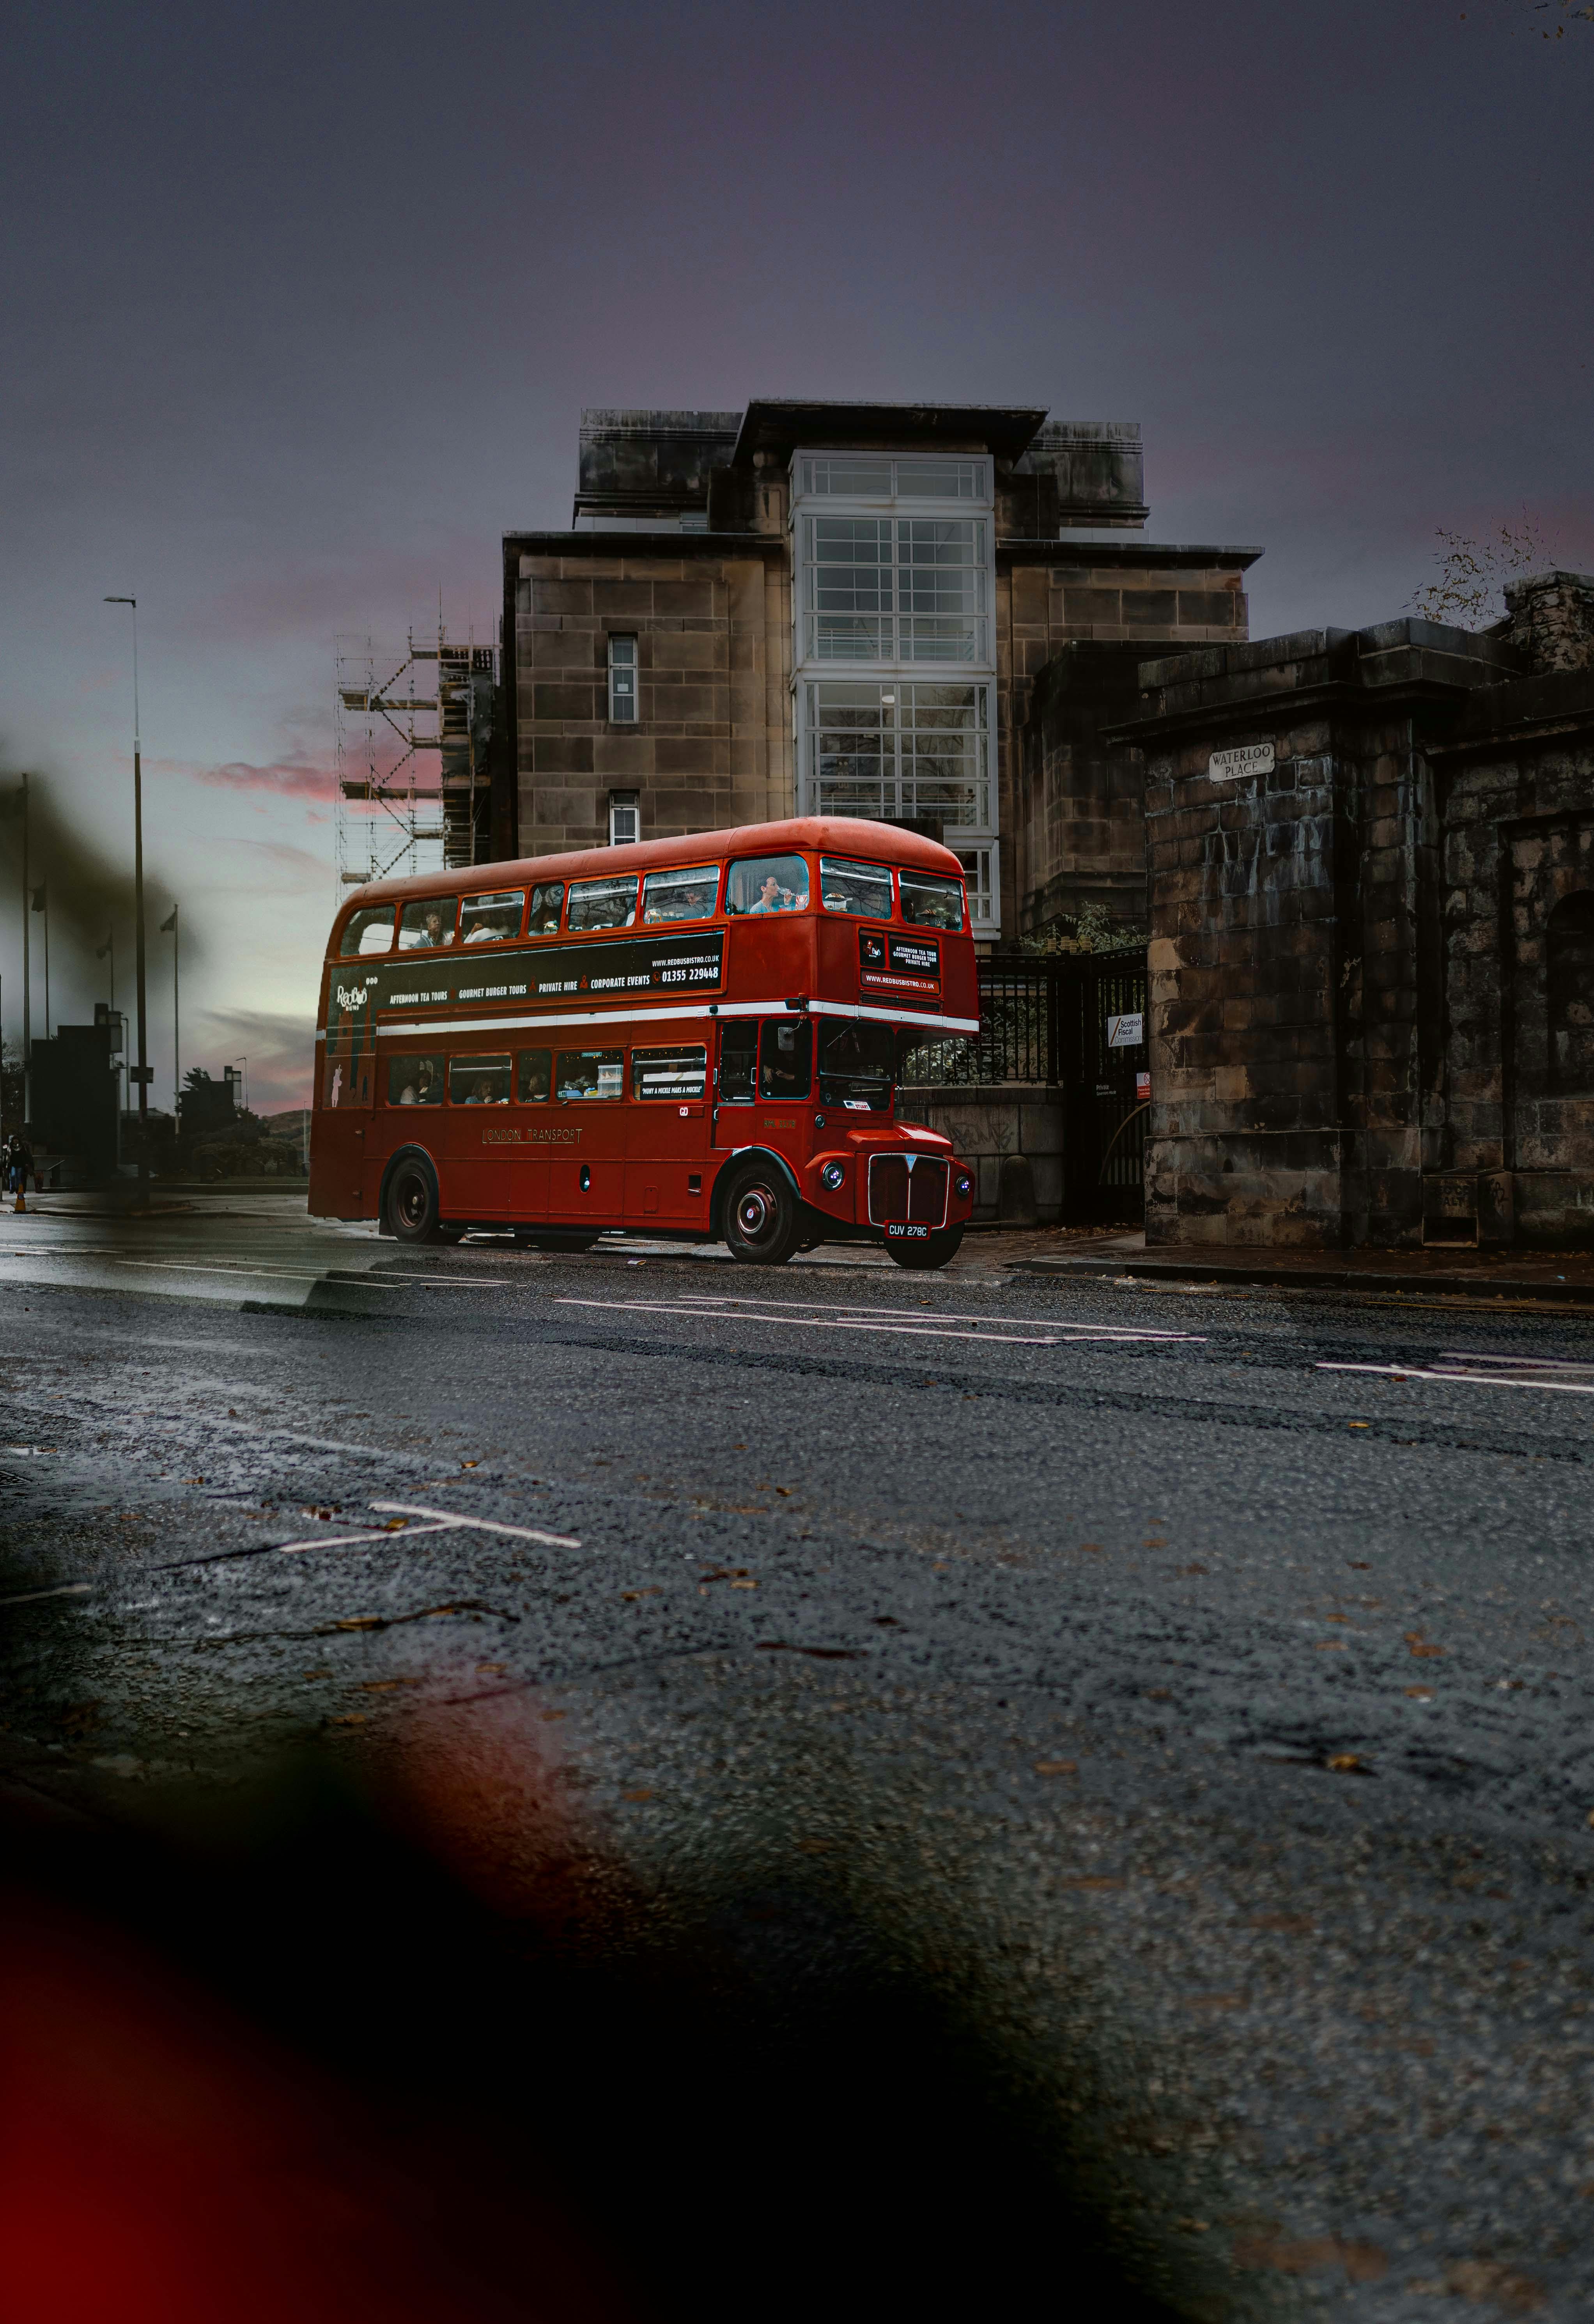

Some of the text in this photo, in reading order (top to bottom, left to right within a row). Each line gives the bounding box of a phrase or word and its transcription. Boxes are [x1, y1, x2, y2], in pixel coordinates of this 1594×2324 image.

[1213, 746, 1270, 766] WATERLOO
[1226, 762, 1257, 777] PLACE
[652, 955, 719, 967] WWW.REDBUSBISTRO.CO.UK
[662, 967, 718, 982] 01355 229448
[539, 981, 577, 993] PRIVATE HIRE
[591, 975, 650, 989] CORPORATE EVENTS
[866, 975, 934, 989] WWW.REDBUSBISTRO.CO.UK
[390, 991, 448, 1004] AFTERNOON TEA TOURS
[459, 985, 526, 999] GOURMET BURGER TOURS
[1121, 1019, 1141, 1028] Scottish
[1118, 1027, 1133, 1036] Fiscal
[1115, 1035, 1141, 1044] Commission
[482, 1129, 583, 1144] LONDON TRANSPORT
[889, 1225, 926, 1236] CUV 278C
